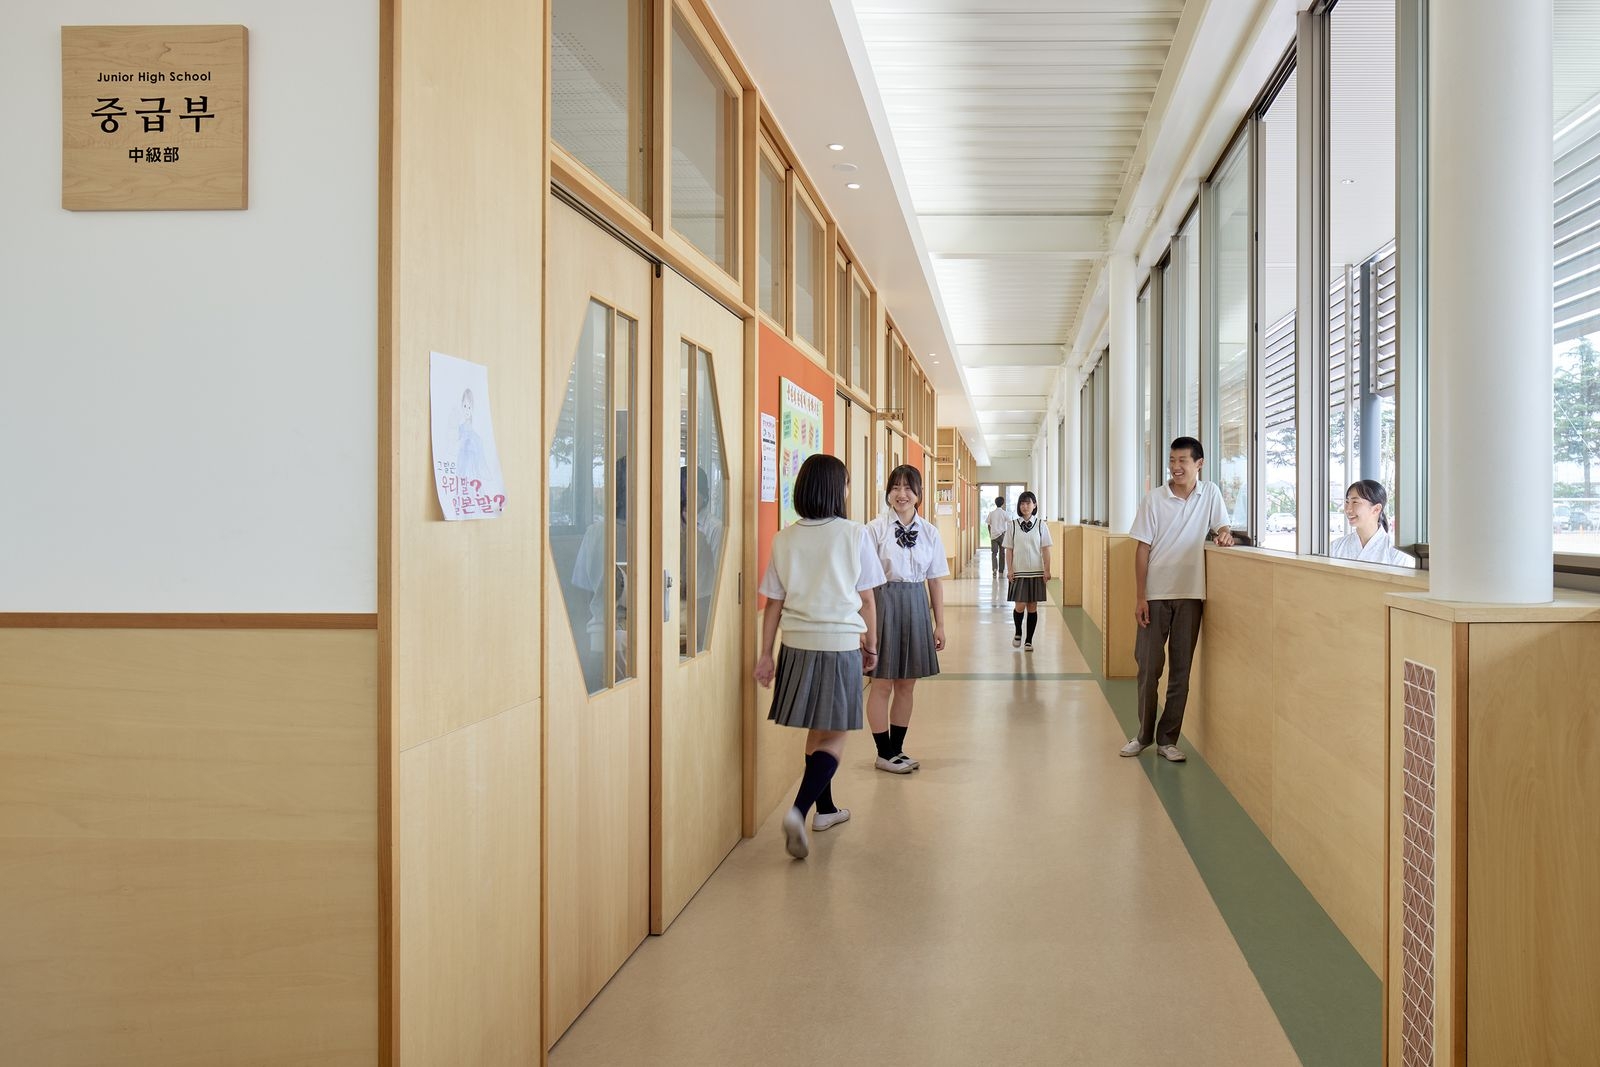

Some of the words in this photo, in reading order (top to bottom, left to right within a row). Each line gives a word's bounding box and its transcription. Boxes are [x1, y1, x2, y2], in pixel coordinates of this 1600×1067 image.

[97, 72, 134, 82] Junior
[138, 71, 165, 84] High
[169, 71, 211, 82] School
[91, 95, 215, 133] 중급부
[128, 147, 180, 163] 中級部
